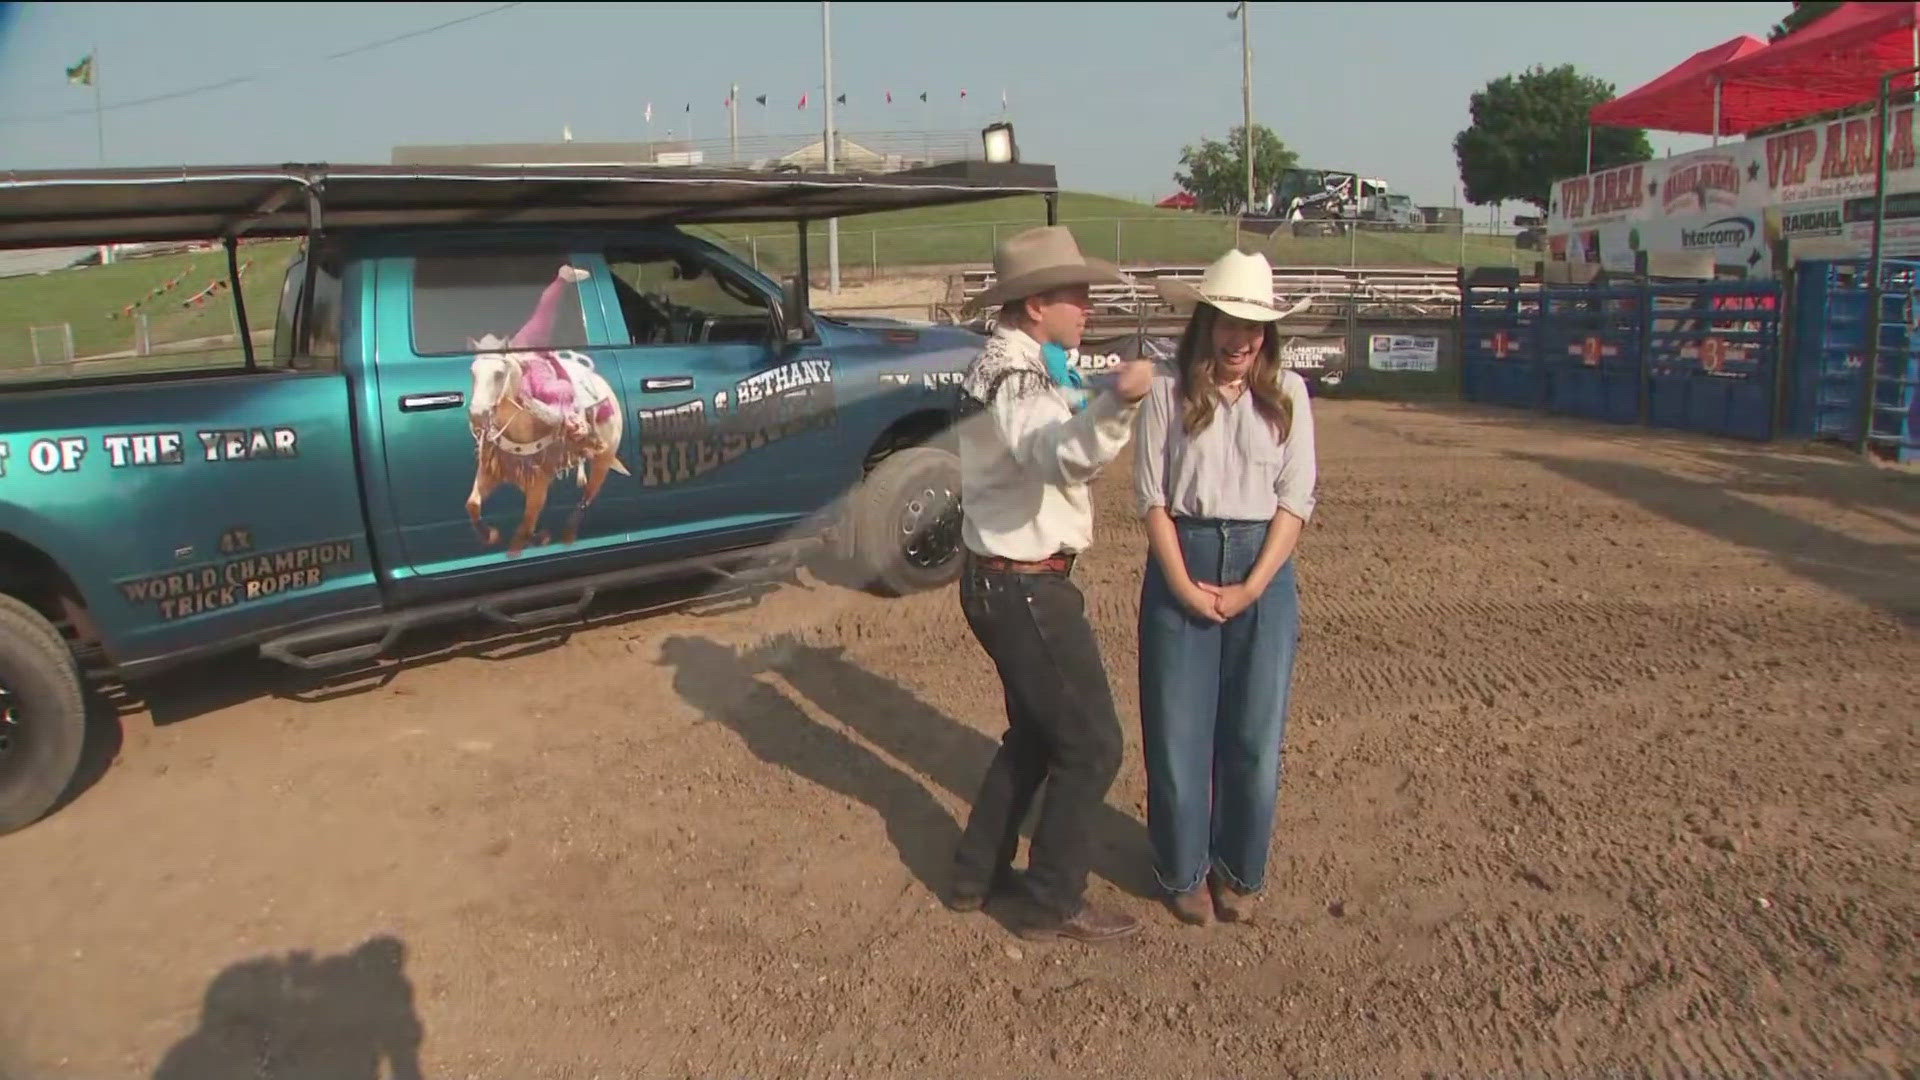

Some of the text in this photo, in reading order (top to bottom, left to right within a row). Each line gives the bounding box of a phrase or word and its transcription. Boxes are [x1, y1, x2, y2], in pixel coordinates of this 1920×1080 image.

[1767, 129, 1818, 190] VIP
[1681, 227, 1746, 248] Intercomp
[736, 359, 832, 405] BETHANY
[29, 436, 87, 474] OF
[103, 431, 184, 468] THE
[198, 427, 299, 463] YEAR
[122, 541, 353, 601] WORLD CHAMPION
[159, 567, 322, 619] TRICK ROPER
